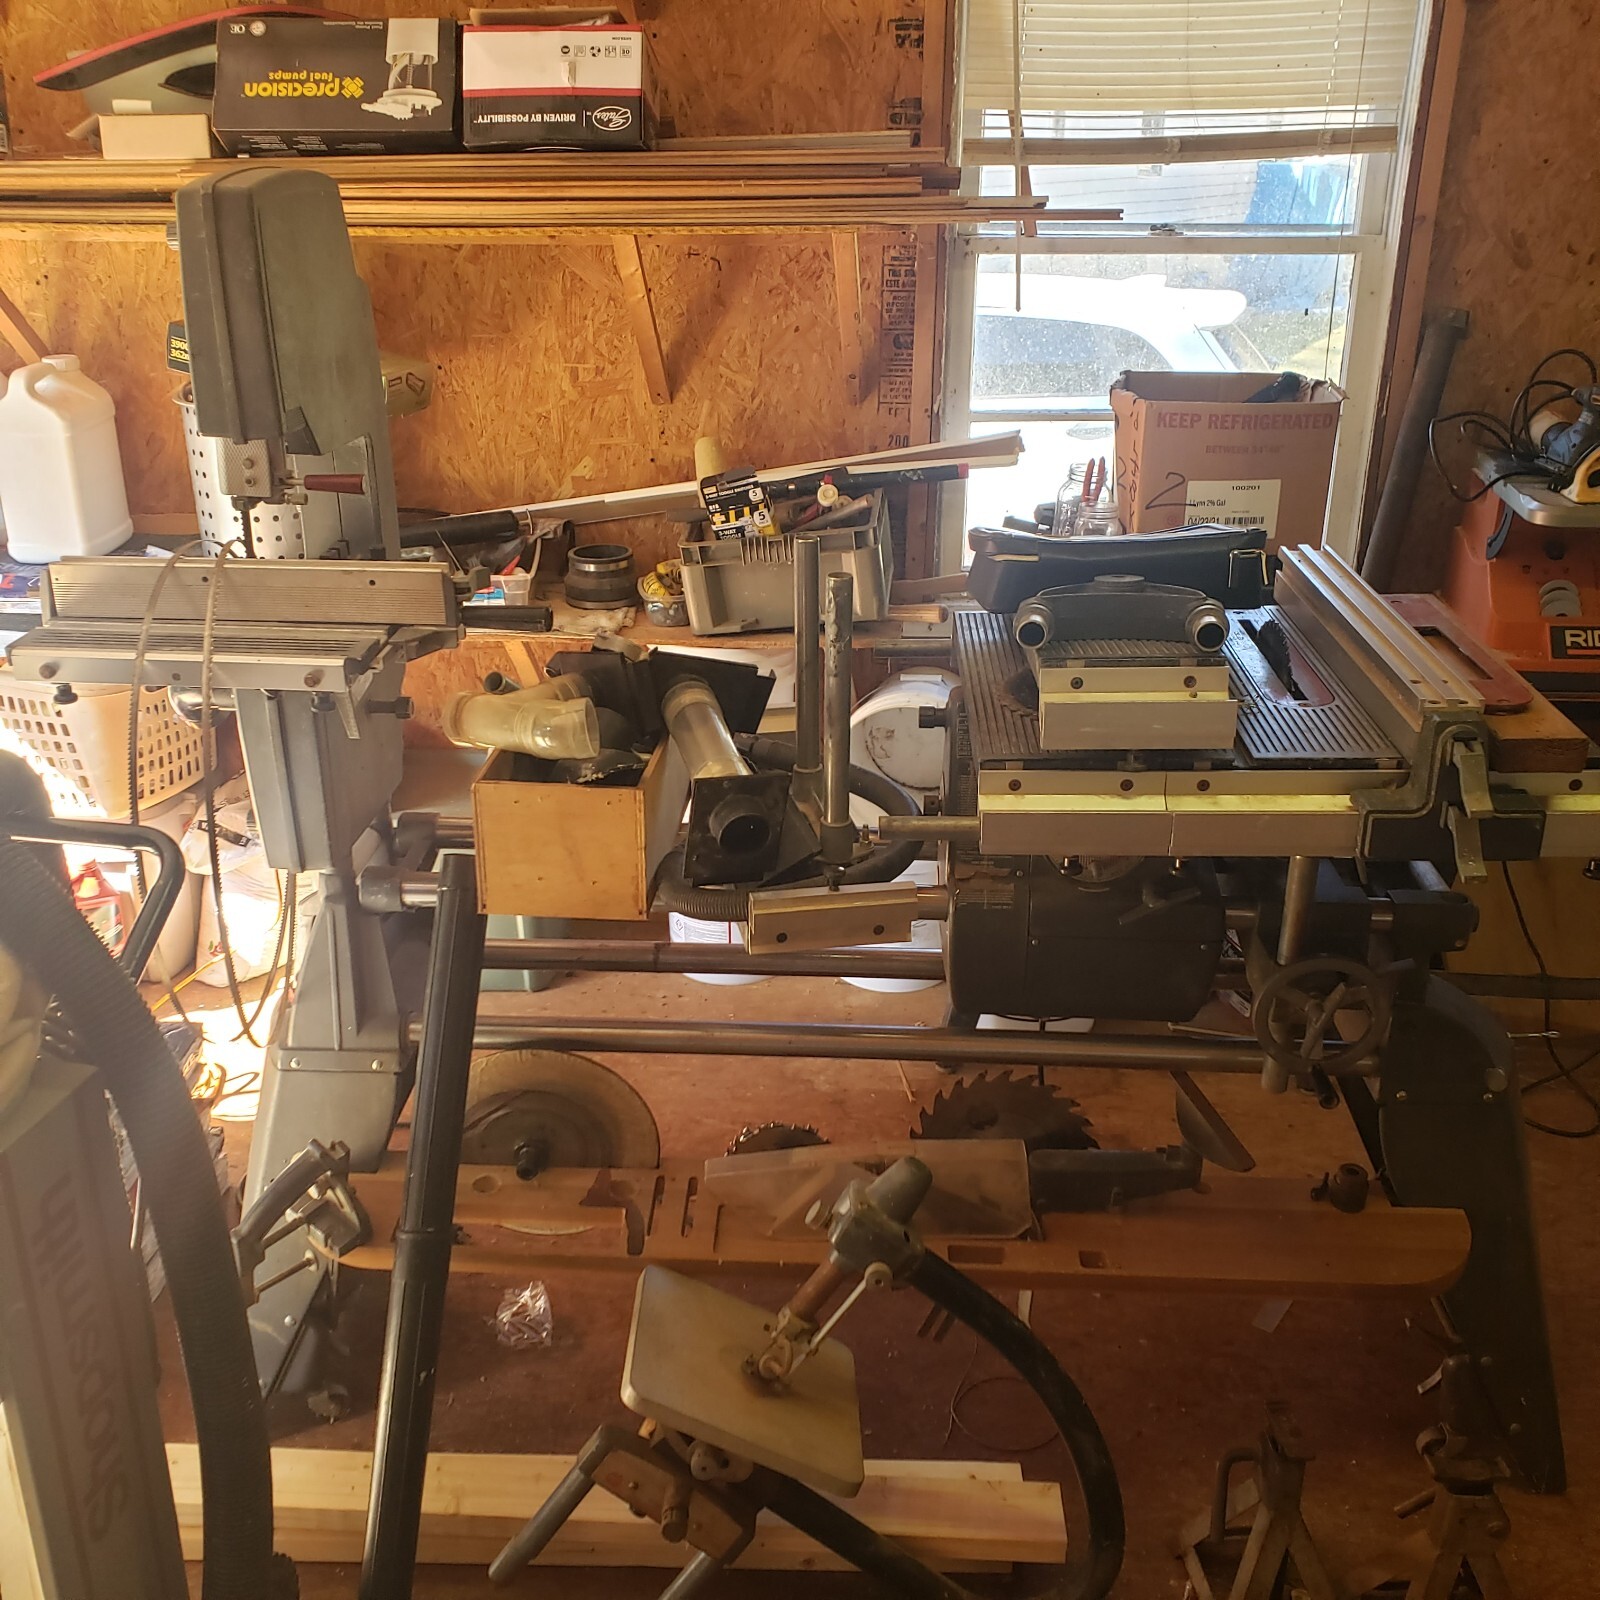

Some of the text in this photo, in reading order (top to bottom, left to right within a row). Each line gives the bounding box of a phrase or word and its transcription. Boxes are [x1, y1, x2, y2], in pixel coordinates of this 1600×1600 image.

[229, 24, 246, 34] OE
[268, 69, 333, 82] fuel pumps
[244, 77, 340, 97] precision
[478, 108, 631, 129] Gates DRIVEN BY POSSIBILITY
[885, 279, 900, 288] ESTE
[1157, 412, 1334, 430] KEEP REFRIGERATED
[1144, 471, 1196, 510] 2
[758, 511, 766, 521] 5
[718, 528, 737, 537] 3-WAY
[1564, 629, 1600, 647] RI
[32, 1172, 131, 1542] Shopsmith
